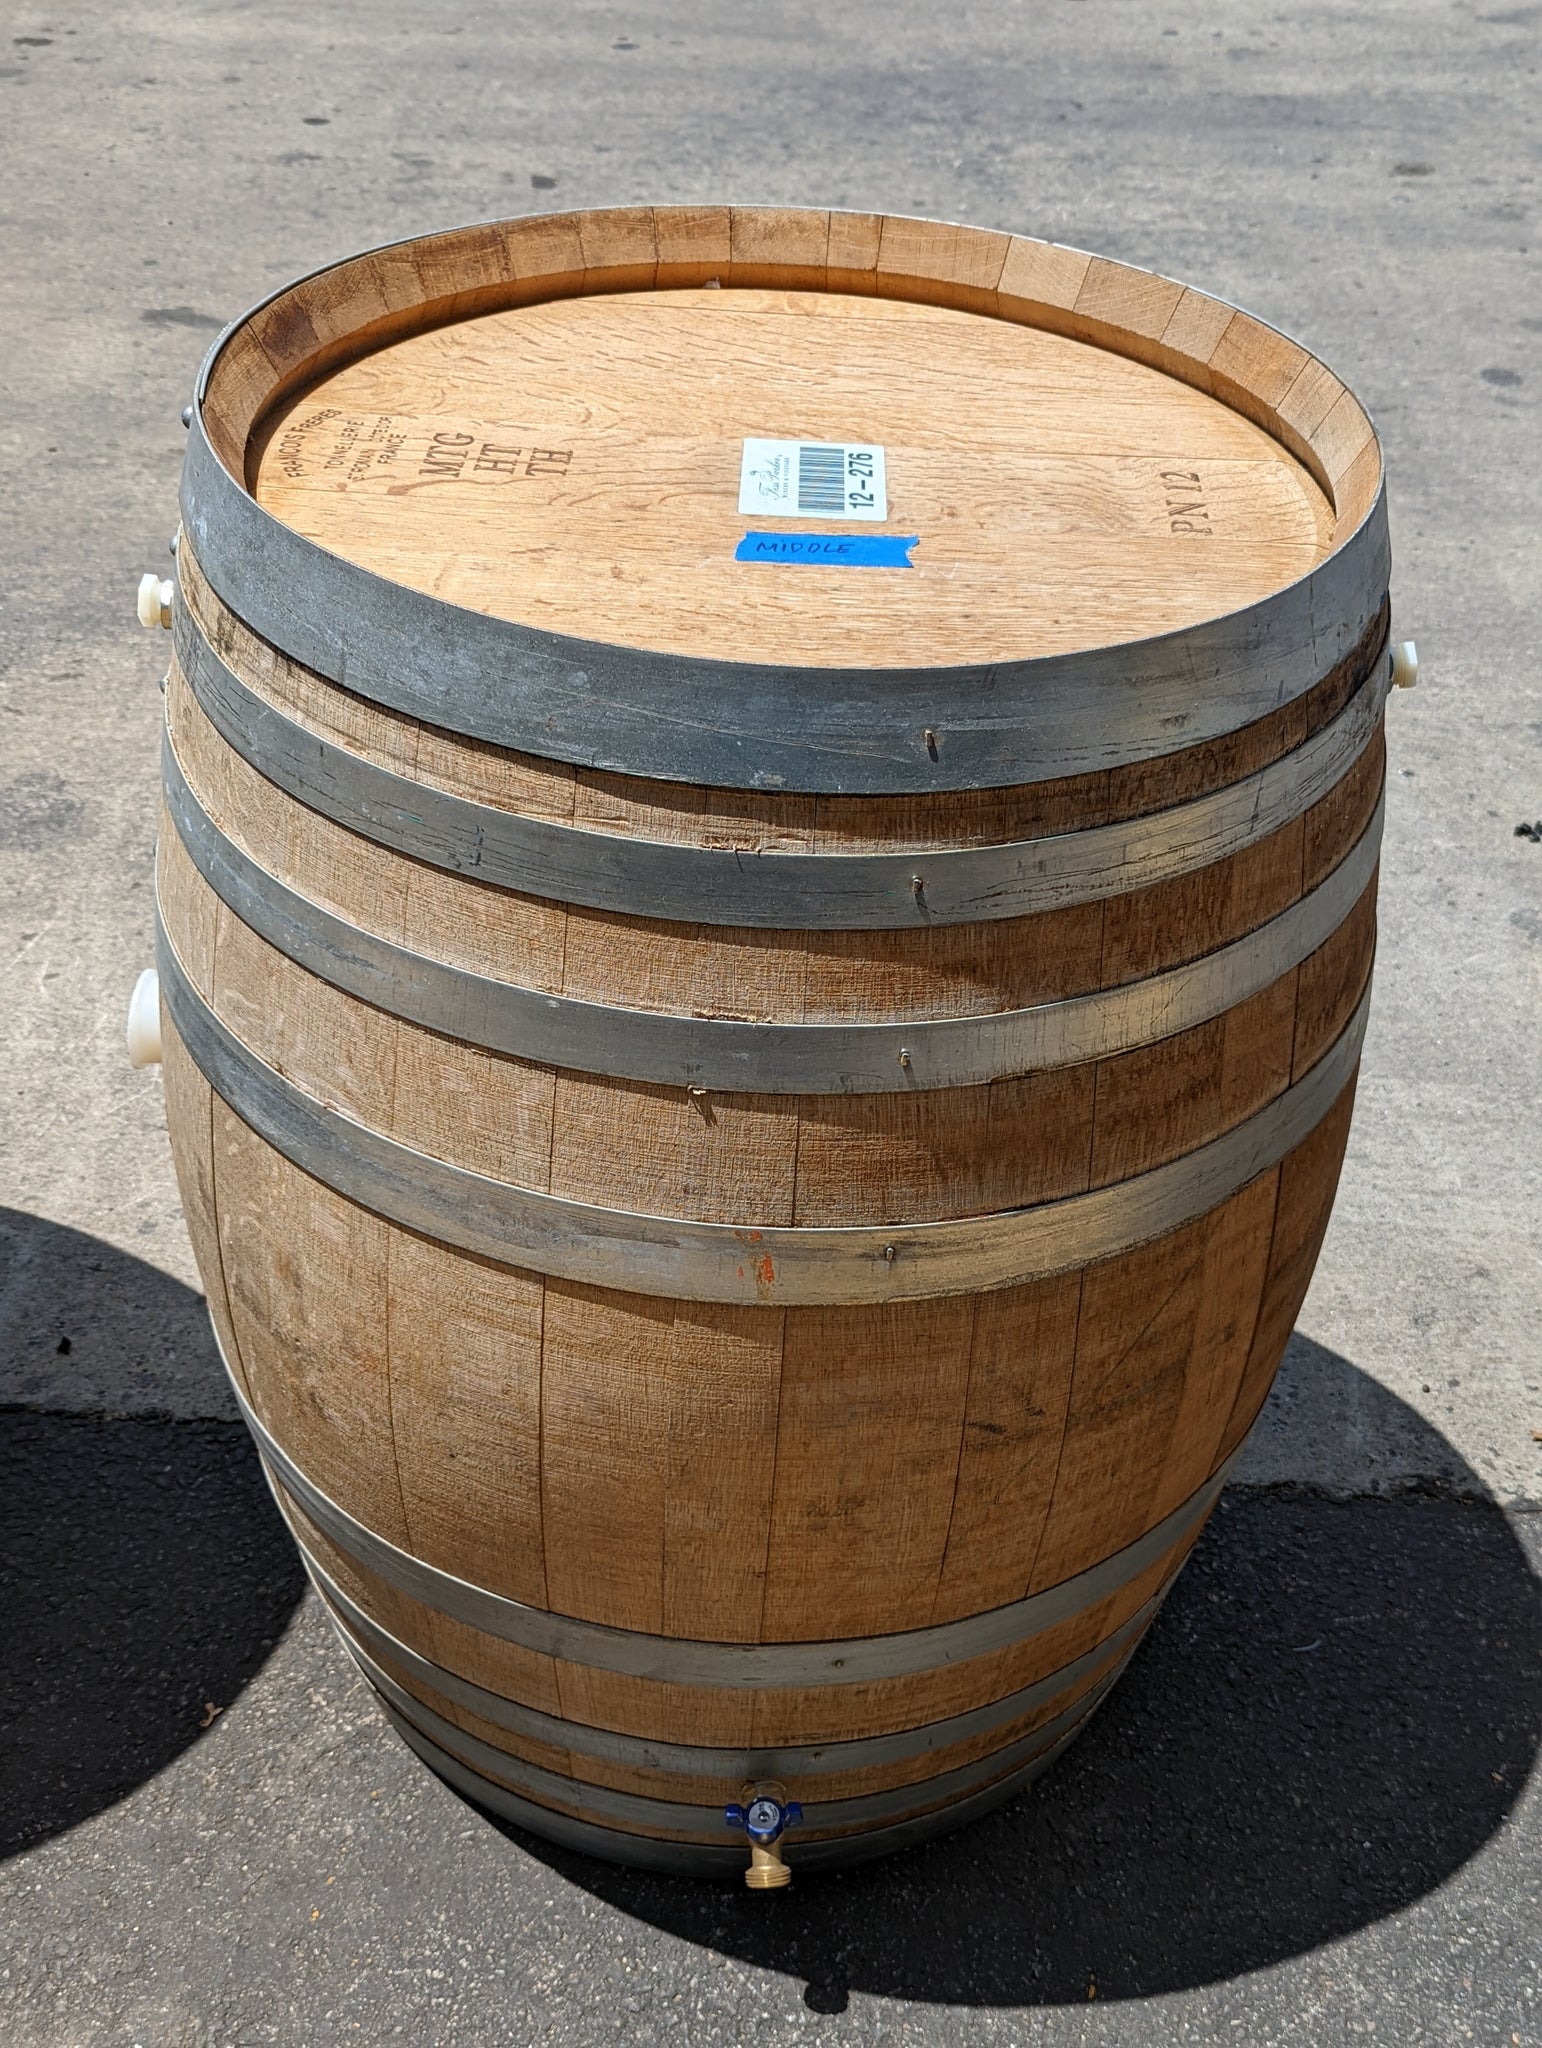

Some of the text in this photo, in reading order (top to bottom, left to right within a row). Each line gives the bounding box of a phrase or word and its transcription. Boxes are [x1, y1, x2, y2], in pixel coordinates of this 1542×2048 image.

[377, 433, 408, 465] FRANCE
[418, 432, 475, 478] MTG
[473, 443, 522, 475] HT
[525, 447, 574, 477] TH
[848, 453, 874, 509] 12-276
[1160, 472, 1212, 535] PN 12
